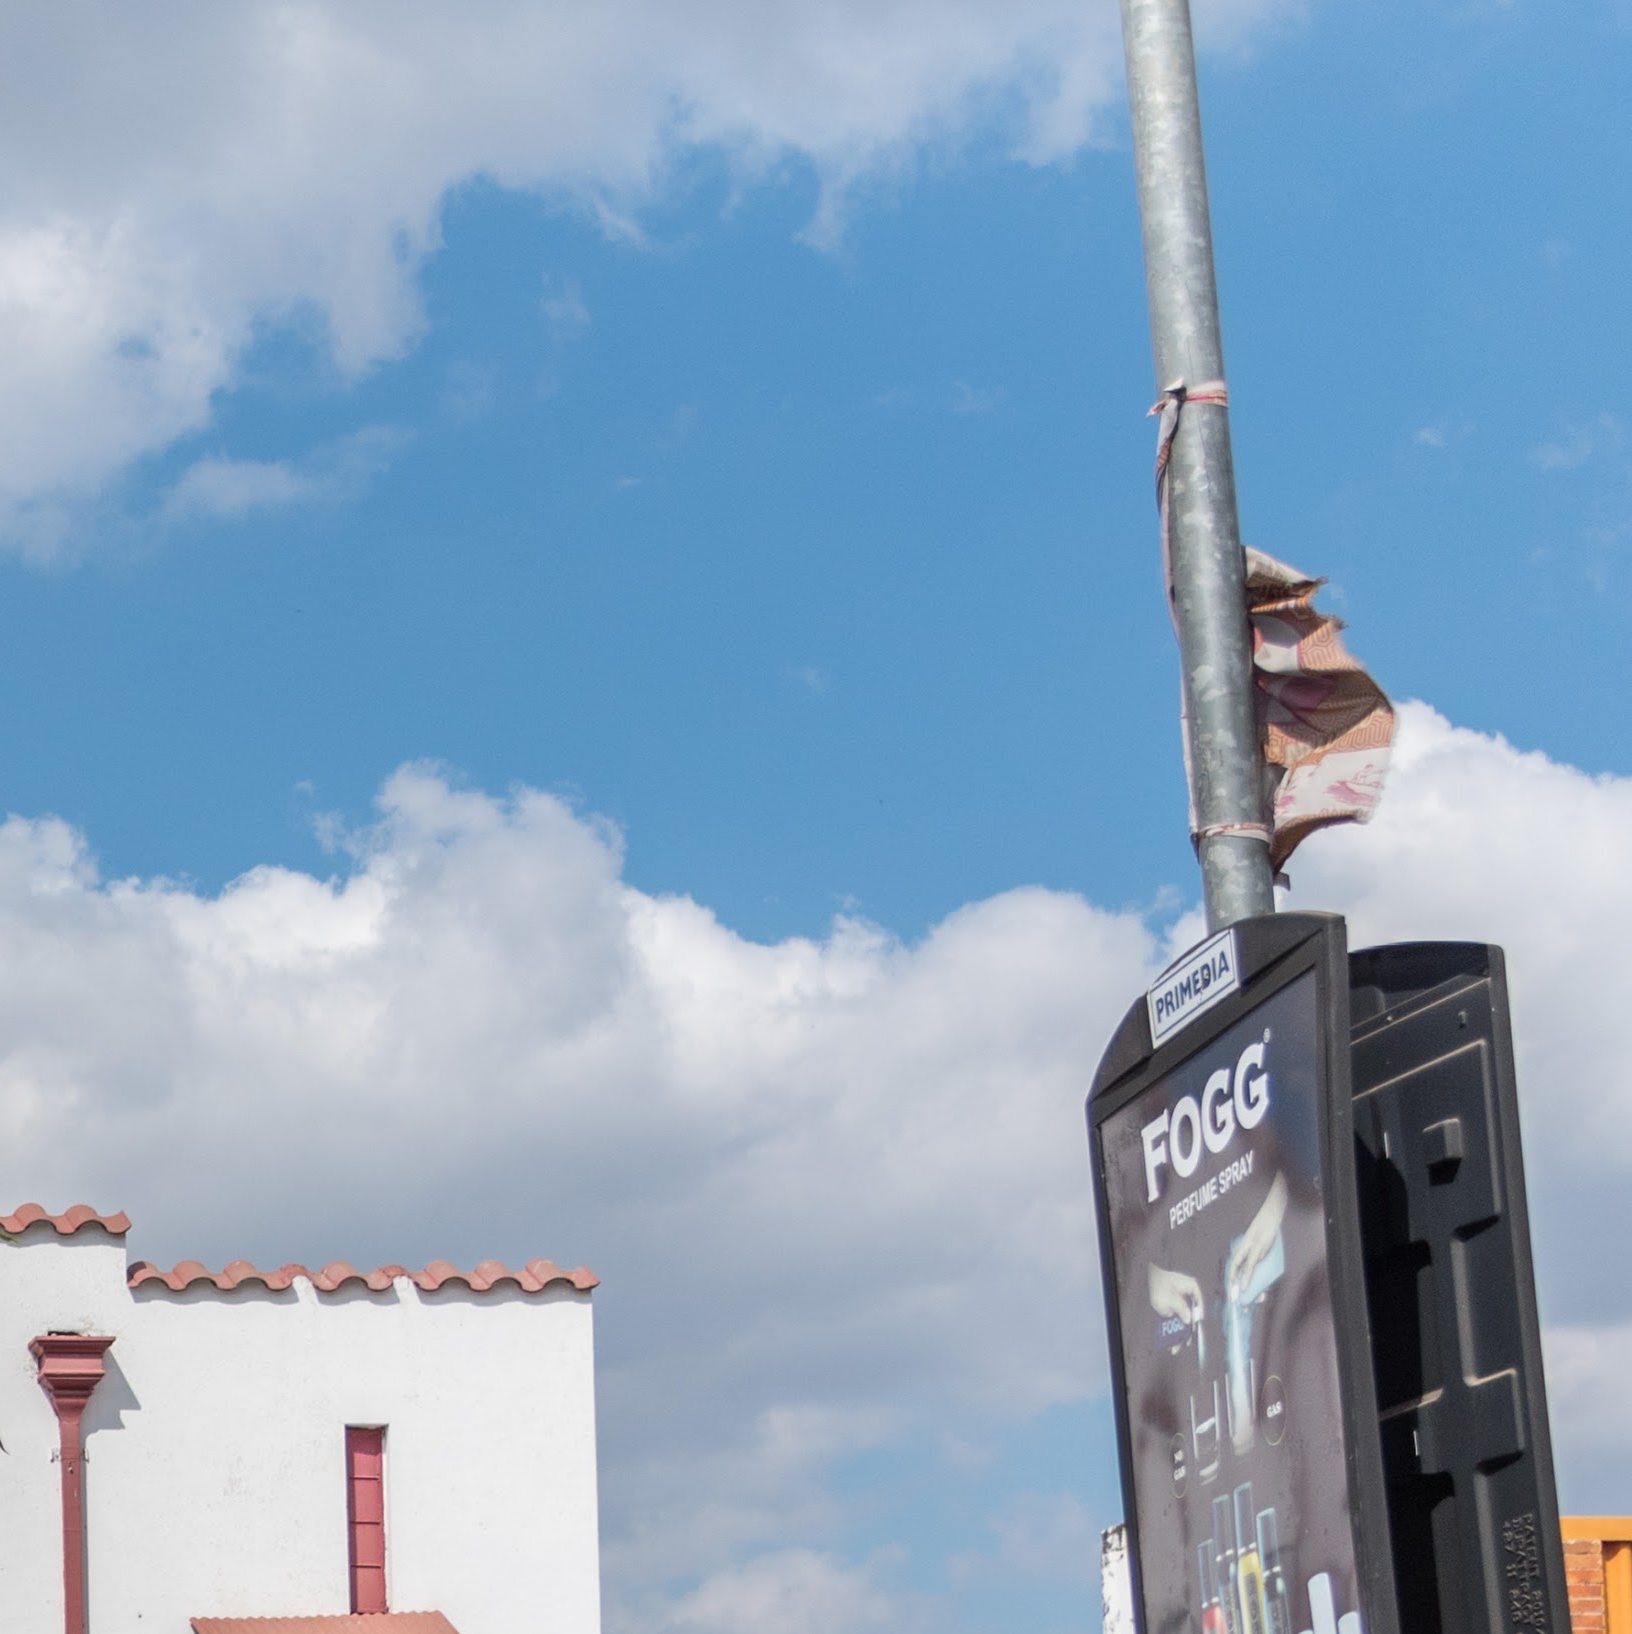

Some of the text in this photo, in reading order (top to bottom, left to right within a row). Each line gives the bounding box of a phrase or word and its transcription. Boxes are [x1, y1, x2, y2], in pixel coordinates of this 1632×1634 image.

[1155, 950, 1229, 1023] PRIMEDIA
[1169, 1149, 1254, 1230] PERFUME SPRAY
[1267, 1400, 1282, 1418] GAS
[1173, 1465, 1186, 1481] GAS
